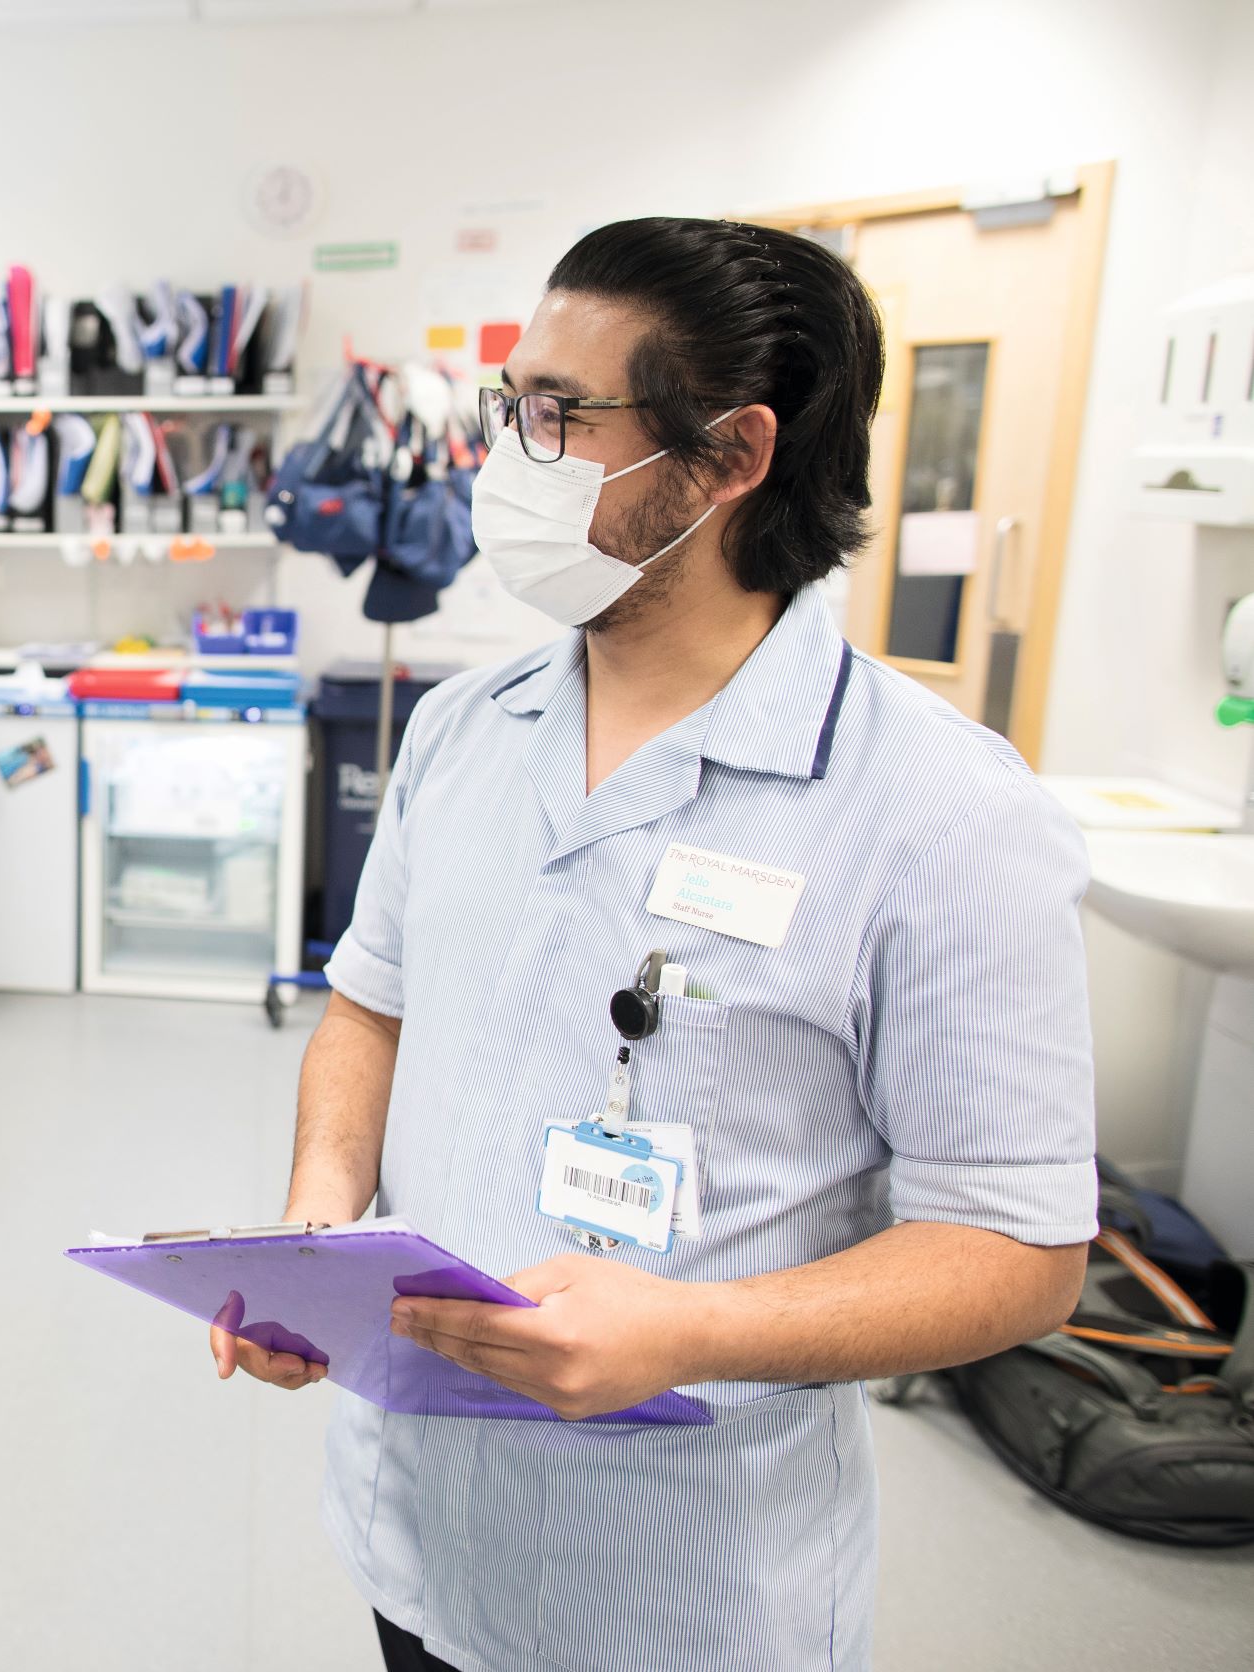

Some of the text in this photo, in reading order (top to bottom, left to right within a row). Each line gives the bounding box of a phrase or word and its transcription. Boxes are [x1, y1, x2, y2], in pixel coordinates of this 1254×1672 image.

[669, 848, 796, 889] The ROYAL MARSDEN
[682, 872, 710, 889] Jello
[677, 888, 734, 911] Alcantara
[672, 902, 714, 920] Staff Nurse
